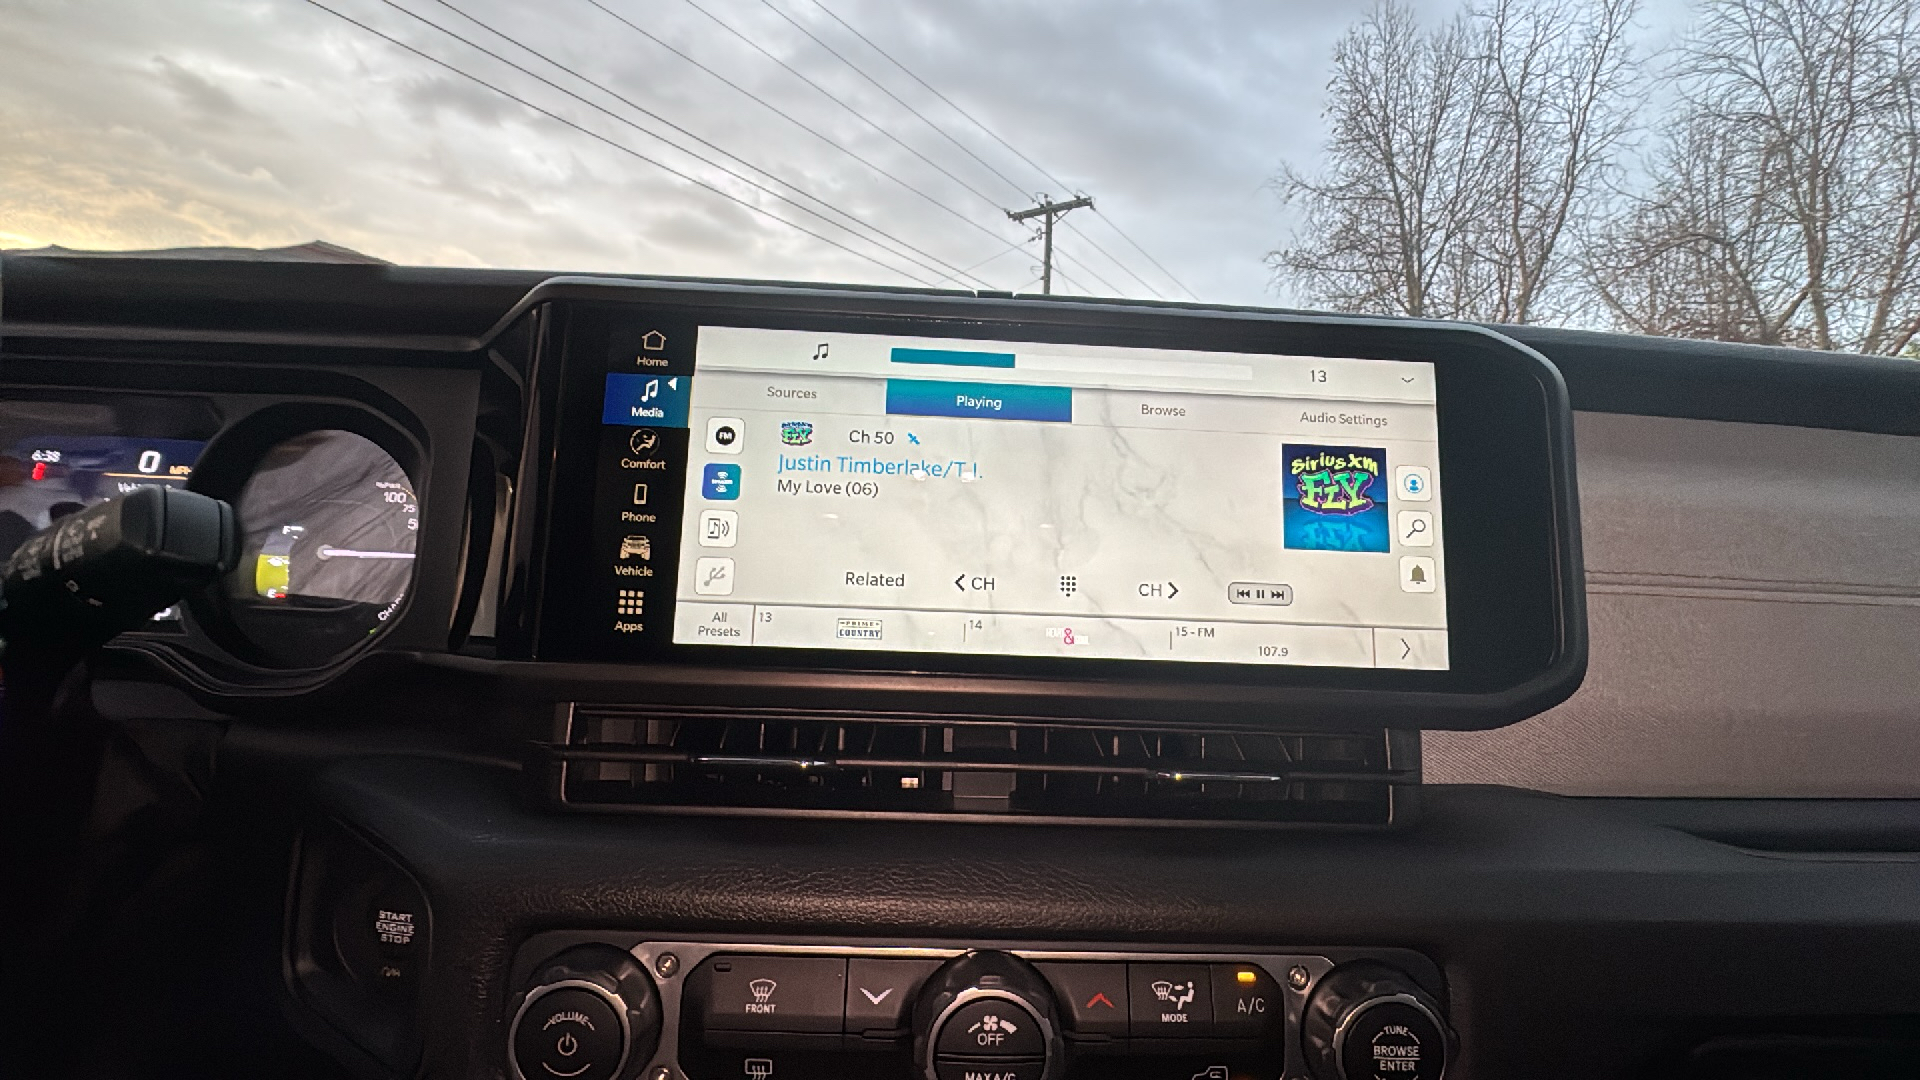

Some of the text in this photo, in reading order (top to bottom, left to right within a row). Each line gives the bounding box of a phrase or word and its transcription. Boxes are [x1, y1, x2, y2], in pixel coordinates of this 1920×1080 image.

[637, 355, 669, 367] Home
[1310, 369, 1327, 383] 13
[766, 386, 818, 400] Sources
[956, 395, 1003, 411] Playing
[631, 406, 665, 419] Media
[1141, 404, 1186, 417] Browse
[1300, 411, 1388, 427] Audio Settings
[718, 431, 733, 440] FM
[849, 429, 895, 445] Ch 50
[138, 450, 161, 473] 0
[621, 458, 666, 470] Comfort
[777, 454, 984, 480] Justin Timberlake/TI.
[777, 479, 879, 498] My Love (06)
[383, 491, 407, 503] 100
[621, 511, 657, 523] Phone
[614, 565, 653, 577] Vehicle
[845, 571, 905, 587] Related
[971, 577, 995, 591] CH
[1138, 583, 1162, 597] CH
[711, 611, 728, 623] All
[759, 611, 773, 623] 13
[614, 621, 643, 633] Apps
[969, 619, 983, 631] 14
[697, 625, 741, 638] Presets
[839, 628, 881, 638] COUNTRY
[1174, 626, 1188, 638] 15
[1197, 627, 1215, 638] FM
[1258, 646, 1288, 657] 107.9
[378, 910, 413, 922] START
[375, 921, 415, 934] ENGINE
[380, 933, 411, 945] STOP
[745, 1003, 777, 1014] FRONT
[1237, 998, 1265, 1014] A/C
[548, 1011, 591, 1026] VOLUME
[1161, 1013, 1189, 1023] MODE
[1383, 1025, 1409, 1036] TUNE
[977, 1033, 1005, 1046] OFF
[1373, 1045, 1420, 1057] BROWSE
[1379, 1060, 1415, 1071] ENTER
